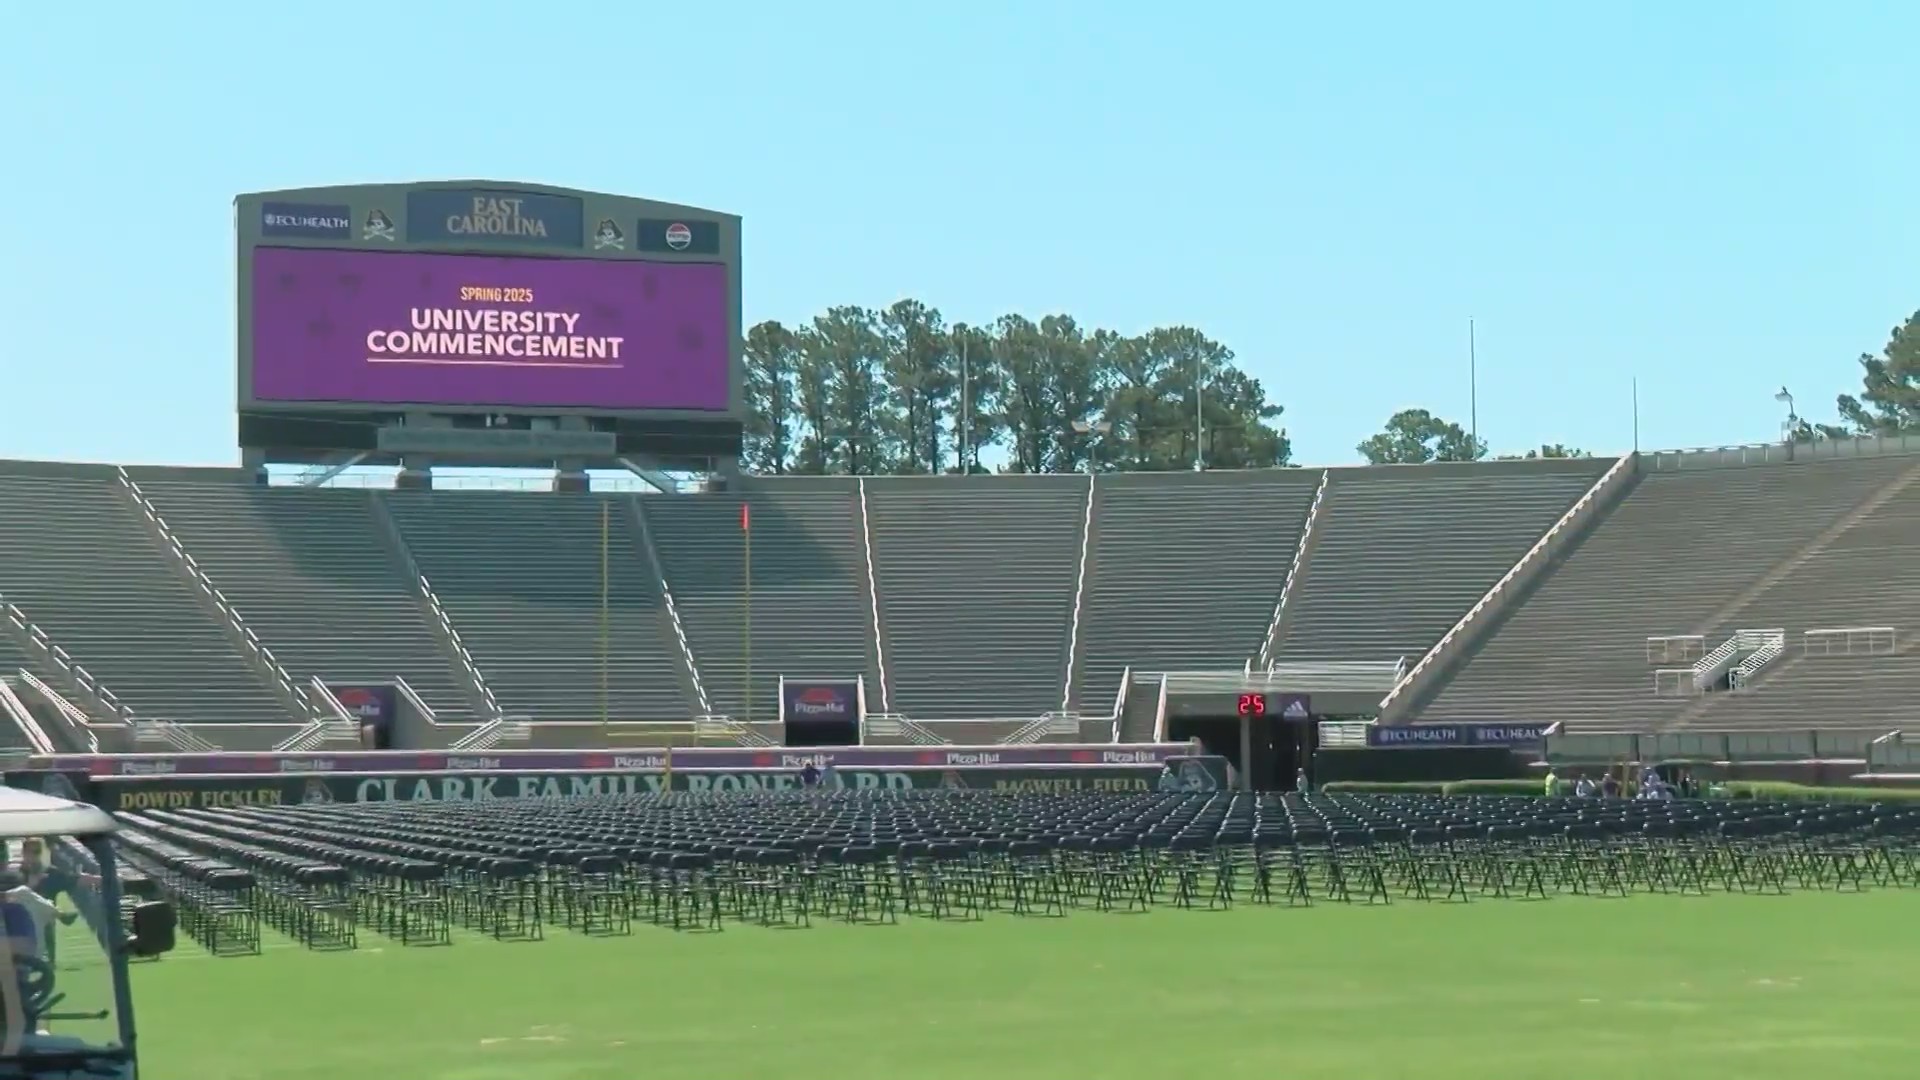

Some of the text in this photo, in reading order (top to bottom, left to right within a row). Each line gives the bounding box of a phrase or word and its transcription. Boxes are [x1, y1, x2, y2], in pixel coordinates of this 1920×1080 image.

[473, 197, 523, 215] EAST
[446, 215, 548, 236] CAROLINA
[460, 287, 533, 303] SPRING 2025
[411, 308, 580, 333] UNIVERSITY
[367, 330, 624, 358] COMMENCEMENT
[1240, 695, 1264, 714] 25
[357, 775, 498, 801] CLARK
[517, 774, 670, 800] FAMILY
[120, 789, 281, 809] DOWDY FICKLEN
